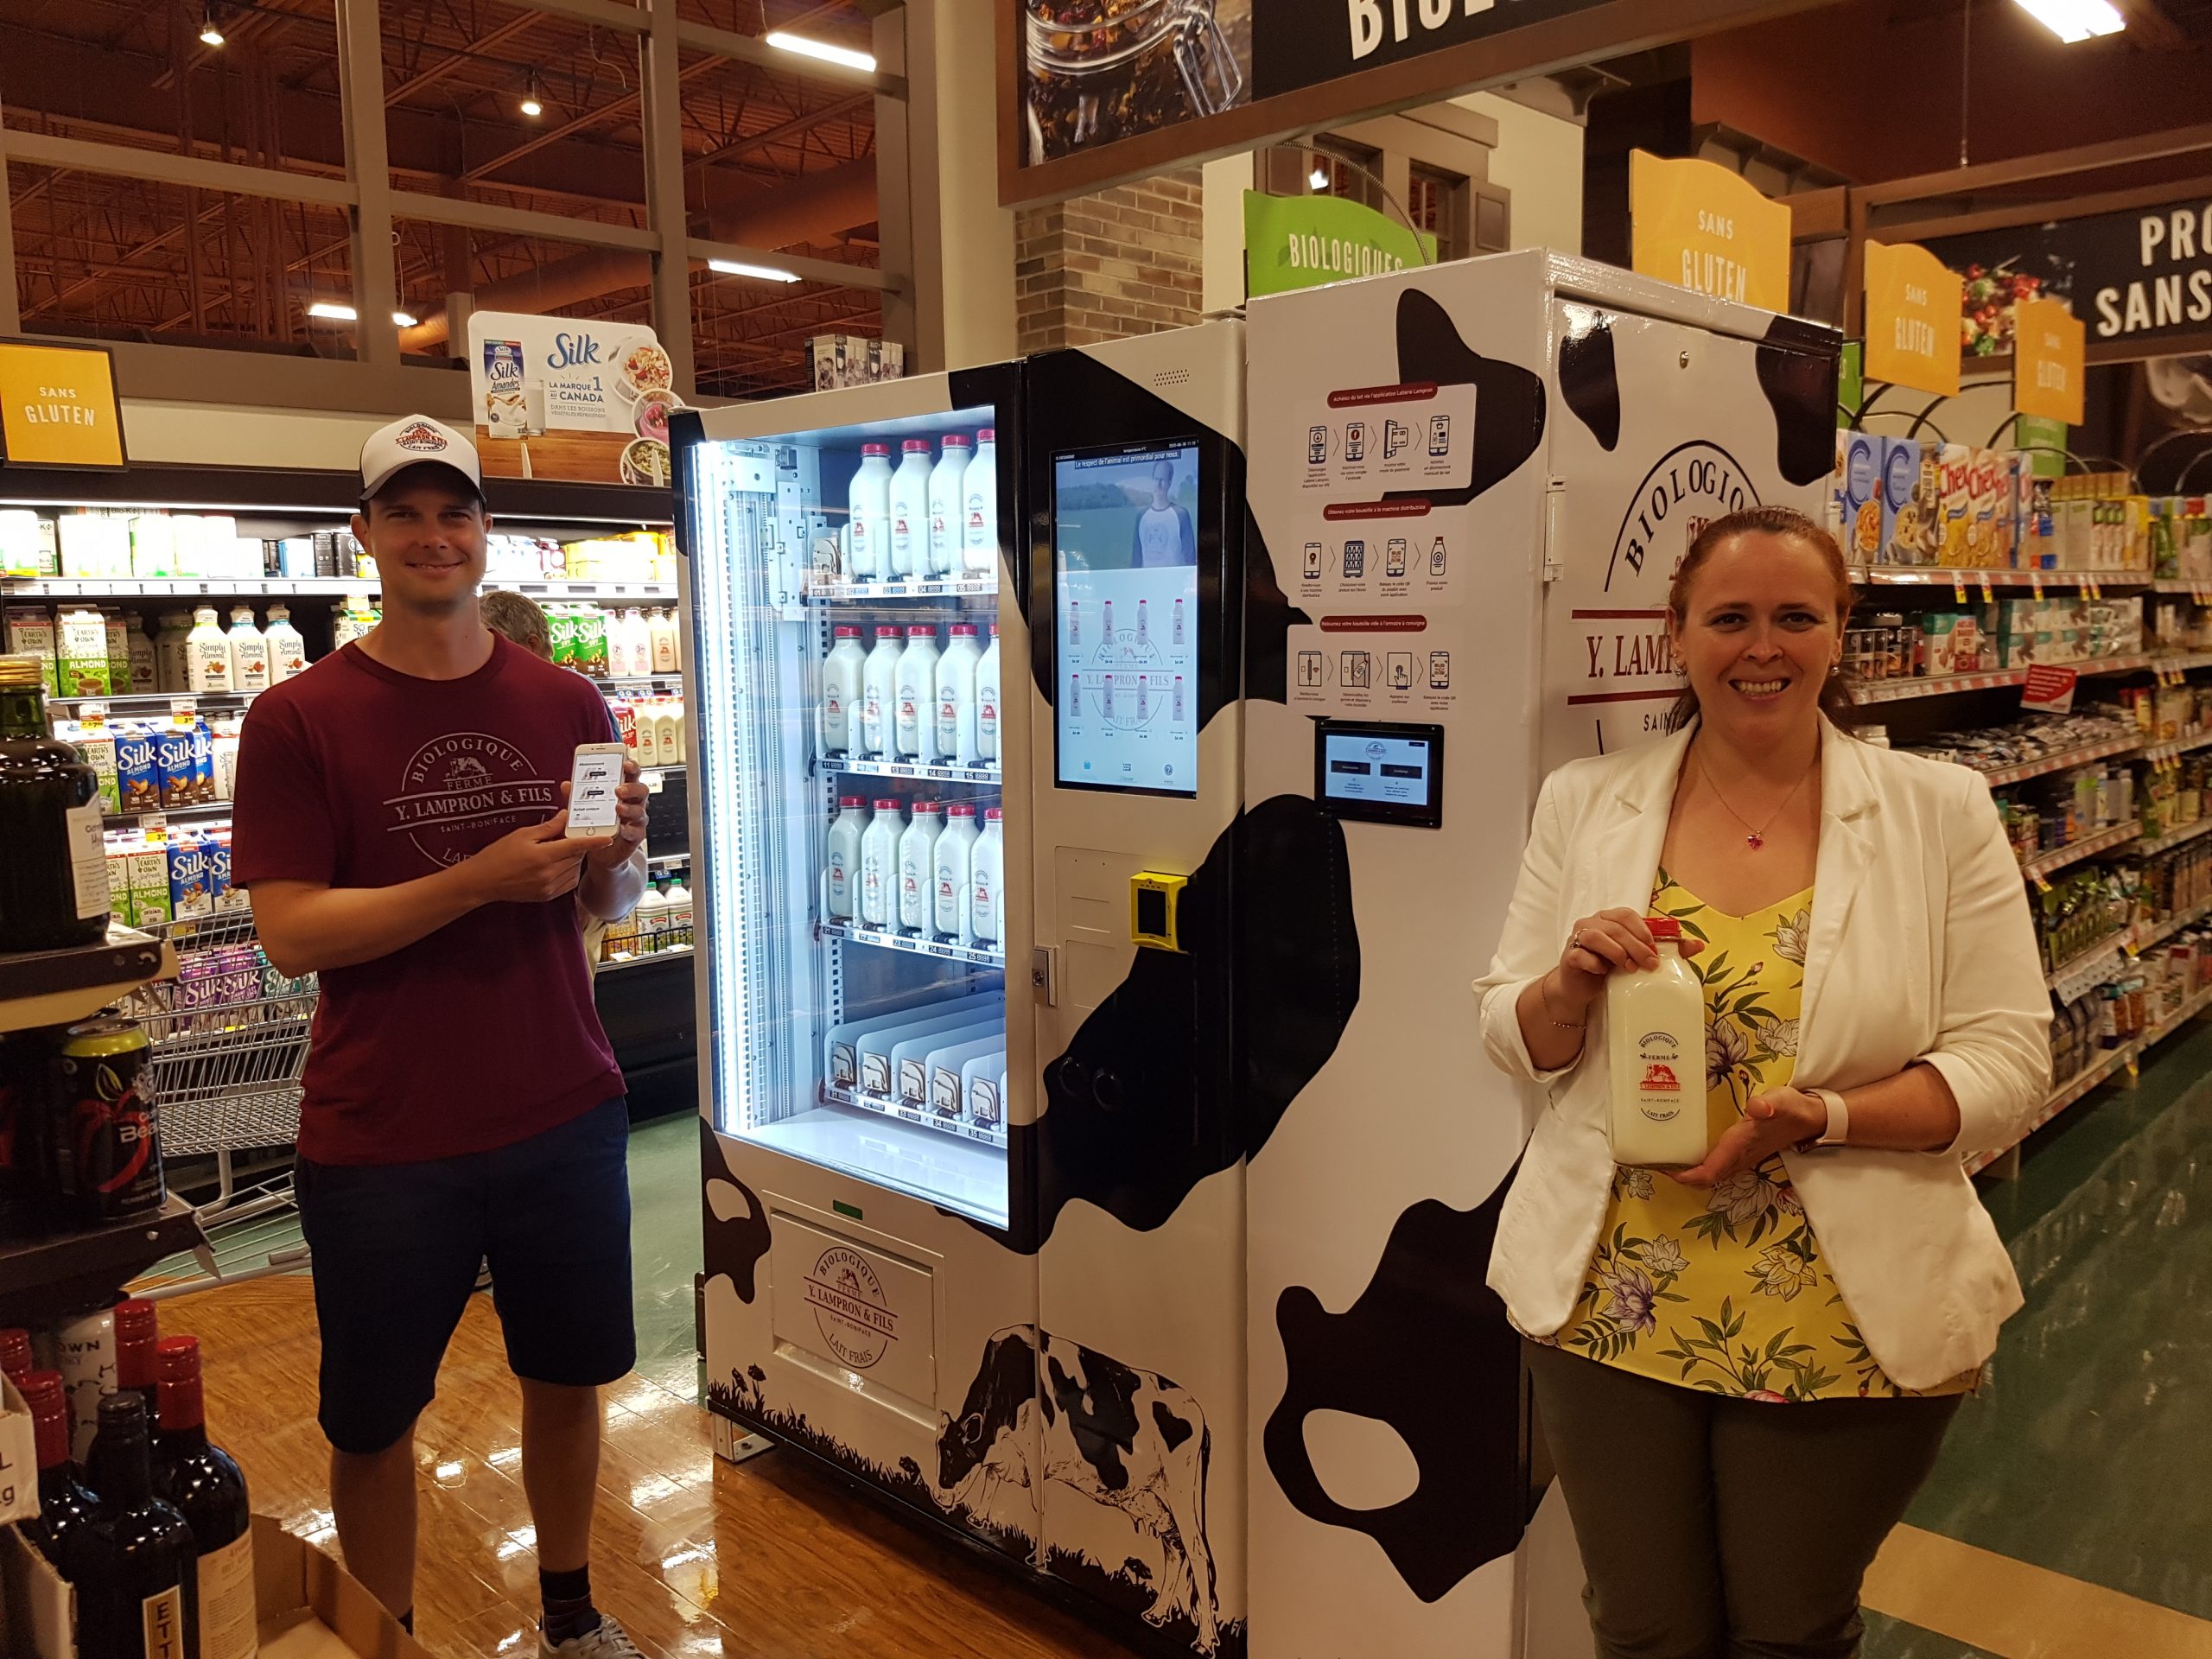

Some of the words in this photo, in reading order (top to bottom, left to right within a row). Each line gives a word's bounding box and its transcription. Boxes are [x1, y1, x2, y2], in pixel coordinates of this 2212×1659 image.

[1698, 209, 1733, 239] SANS
[1681, 248, 1746, 302] GLUTEN
[2095, 270, 2212, 337] SANS
[547, 333, 601, 370] Silk
[491, 362, 518, 380] Silk
[39, 386, 77, 398] SANS
[492, 379, 519, 391] Amandes
[559, 382, 591, 392] MARQUE
[593, 376, 603, 391] 1
[559, 391, 604, 403] CANADA
[24, 404, 95, 426] GLUTEN
[1939, 463, 1970, 498] Chex
[550, 620, 579, 644] Silk
[577, 620, 607, 642] Silk
[199, 642, 226, 654] Simply
[239, 642, 264, 654] Simply
[1586, 636, 1605, 678] Y.
[69, 660, 106, 669] ALMOND
[1096, 674, 1137, 686] LAPRON
[620, 715, 636, 733] ilk
[118, 743, 156, 771] Silk
[157, 740, 195, 768] Silk
[411, 737, 524, 785] BIOLOGIQUE
[127, 763, 151, 775] ALMOND
[167, 760, 191, 772] ALMOND
[447, 776, 494, 791] FERME
[395, 805, 410, 821] Y.
[415, 792, 495, 817] LAMPRON
[500, 790, 513, 804] &
[518, 787, 552, 803] FILS
[441, 815, 517, 833] SAINT-BONIFACE
[171, 852, 210, 881] Silk
[181, 872, 204, 884] ALMOND
[133, 888, 168, 899] ALMOND
[1641, 1035, 1677, 1048] BIOLOGIQUE
[819, 1252, 880, 1298] BIOLOGIQUE
[818, 1289, 861, 1318] LAMPRON
[874, 1313, 893, 1332] FILS
[829, 1333, 847, 1357] LAIT
[849, 1349, 873, 1363] FRAIS
